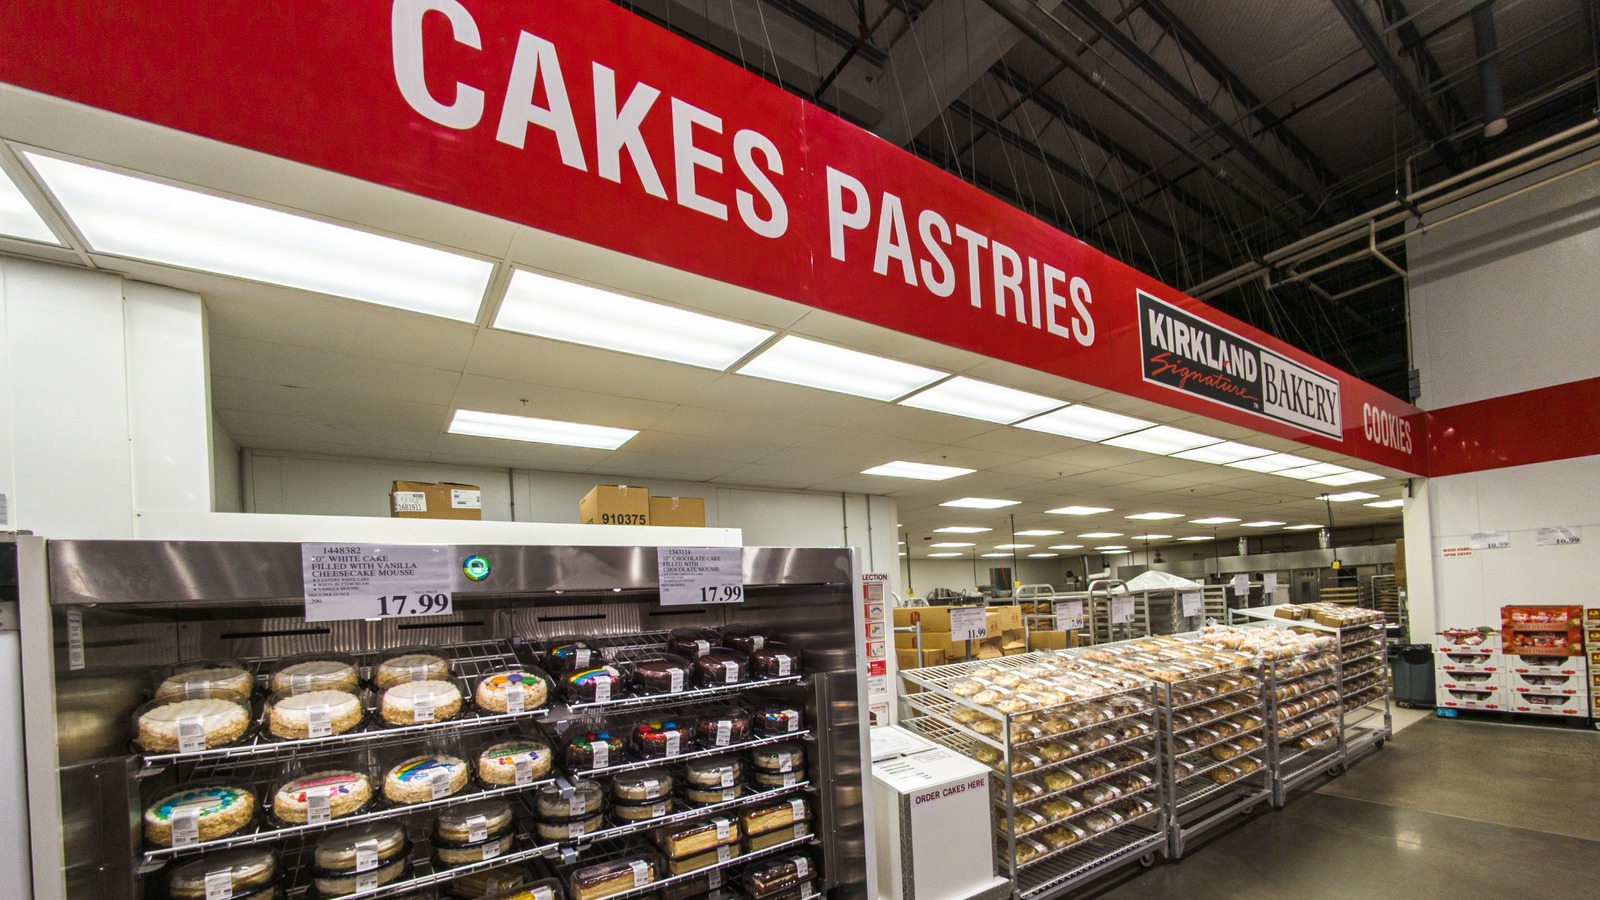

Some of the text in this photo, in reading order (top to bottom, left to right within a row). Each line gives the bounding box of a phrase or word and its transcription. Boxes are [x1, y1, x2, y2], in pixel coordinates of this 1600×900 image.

[391, 0, 1096, 347] CAKES PASTRIES
[1149, 308, 1258, 384] KIRKLAND
[1150, 352, 1259, 390] Signature
[1262, 361, 1337, 426] BAKERY
[1363, 402, 1413, 455] COOKIES
[602, 513, 646, 525] 910375
[1487, 541, 1509, 549] 10.99
[1556, 537, 1580, 545] 10.99
[323, 547, 361, 555] 1448382
[312, 562, 418, 571] FILLED WITH VANILLA
[312, 569, 415, 578] CHEESECAKE MOUSSE
[862, 573, 888, 581] LECTION
[700, 585, 742, 602] 17.99
[376, 593, 449, 616] 17.99
[968, 628, 986, 639] 11.99
[915, 778, 985, 805] ORDER CAKES HERE
